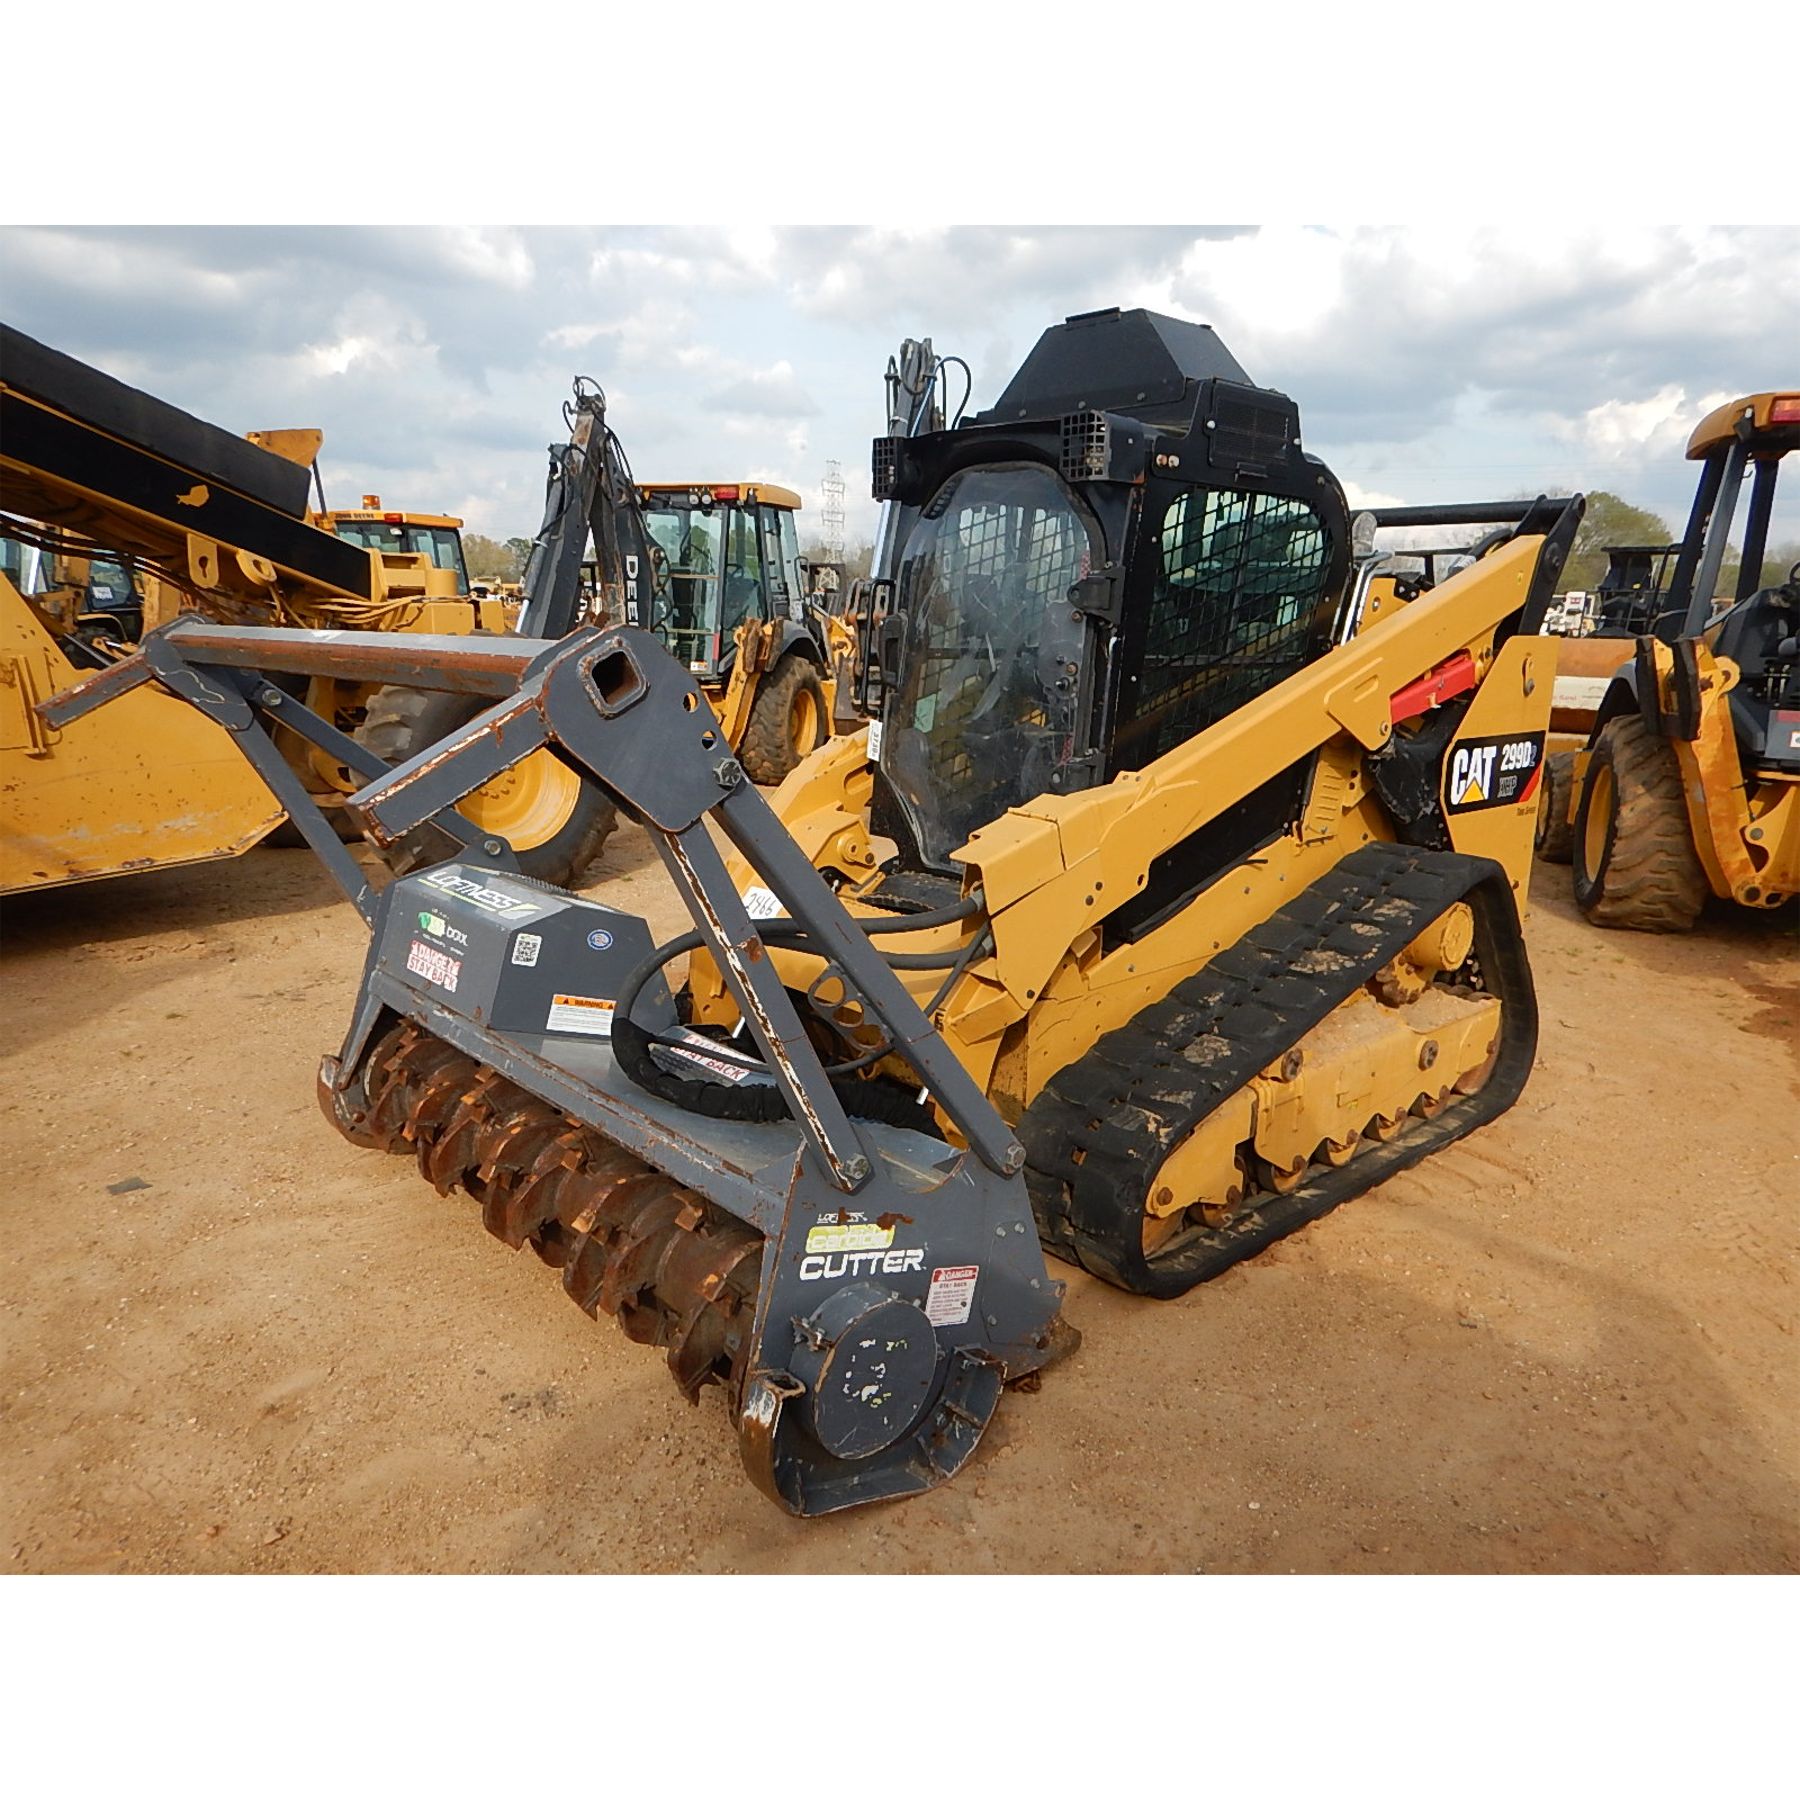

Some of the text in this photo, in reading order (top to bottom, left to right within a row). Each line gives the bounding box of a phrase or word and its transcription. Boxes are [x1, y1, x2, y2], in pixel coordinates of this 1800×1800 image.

[626, 555, 639, 627] DEE
[1450, 745, 1497, 805] CAT
[408, 955, 432, 976] STAY
[799, 1248, 925, 1281] CUTTER
[945, 1270, 972, 1281] DANGER
